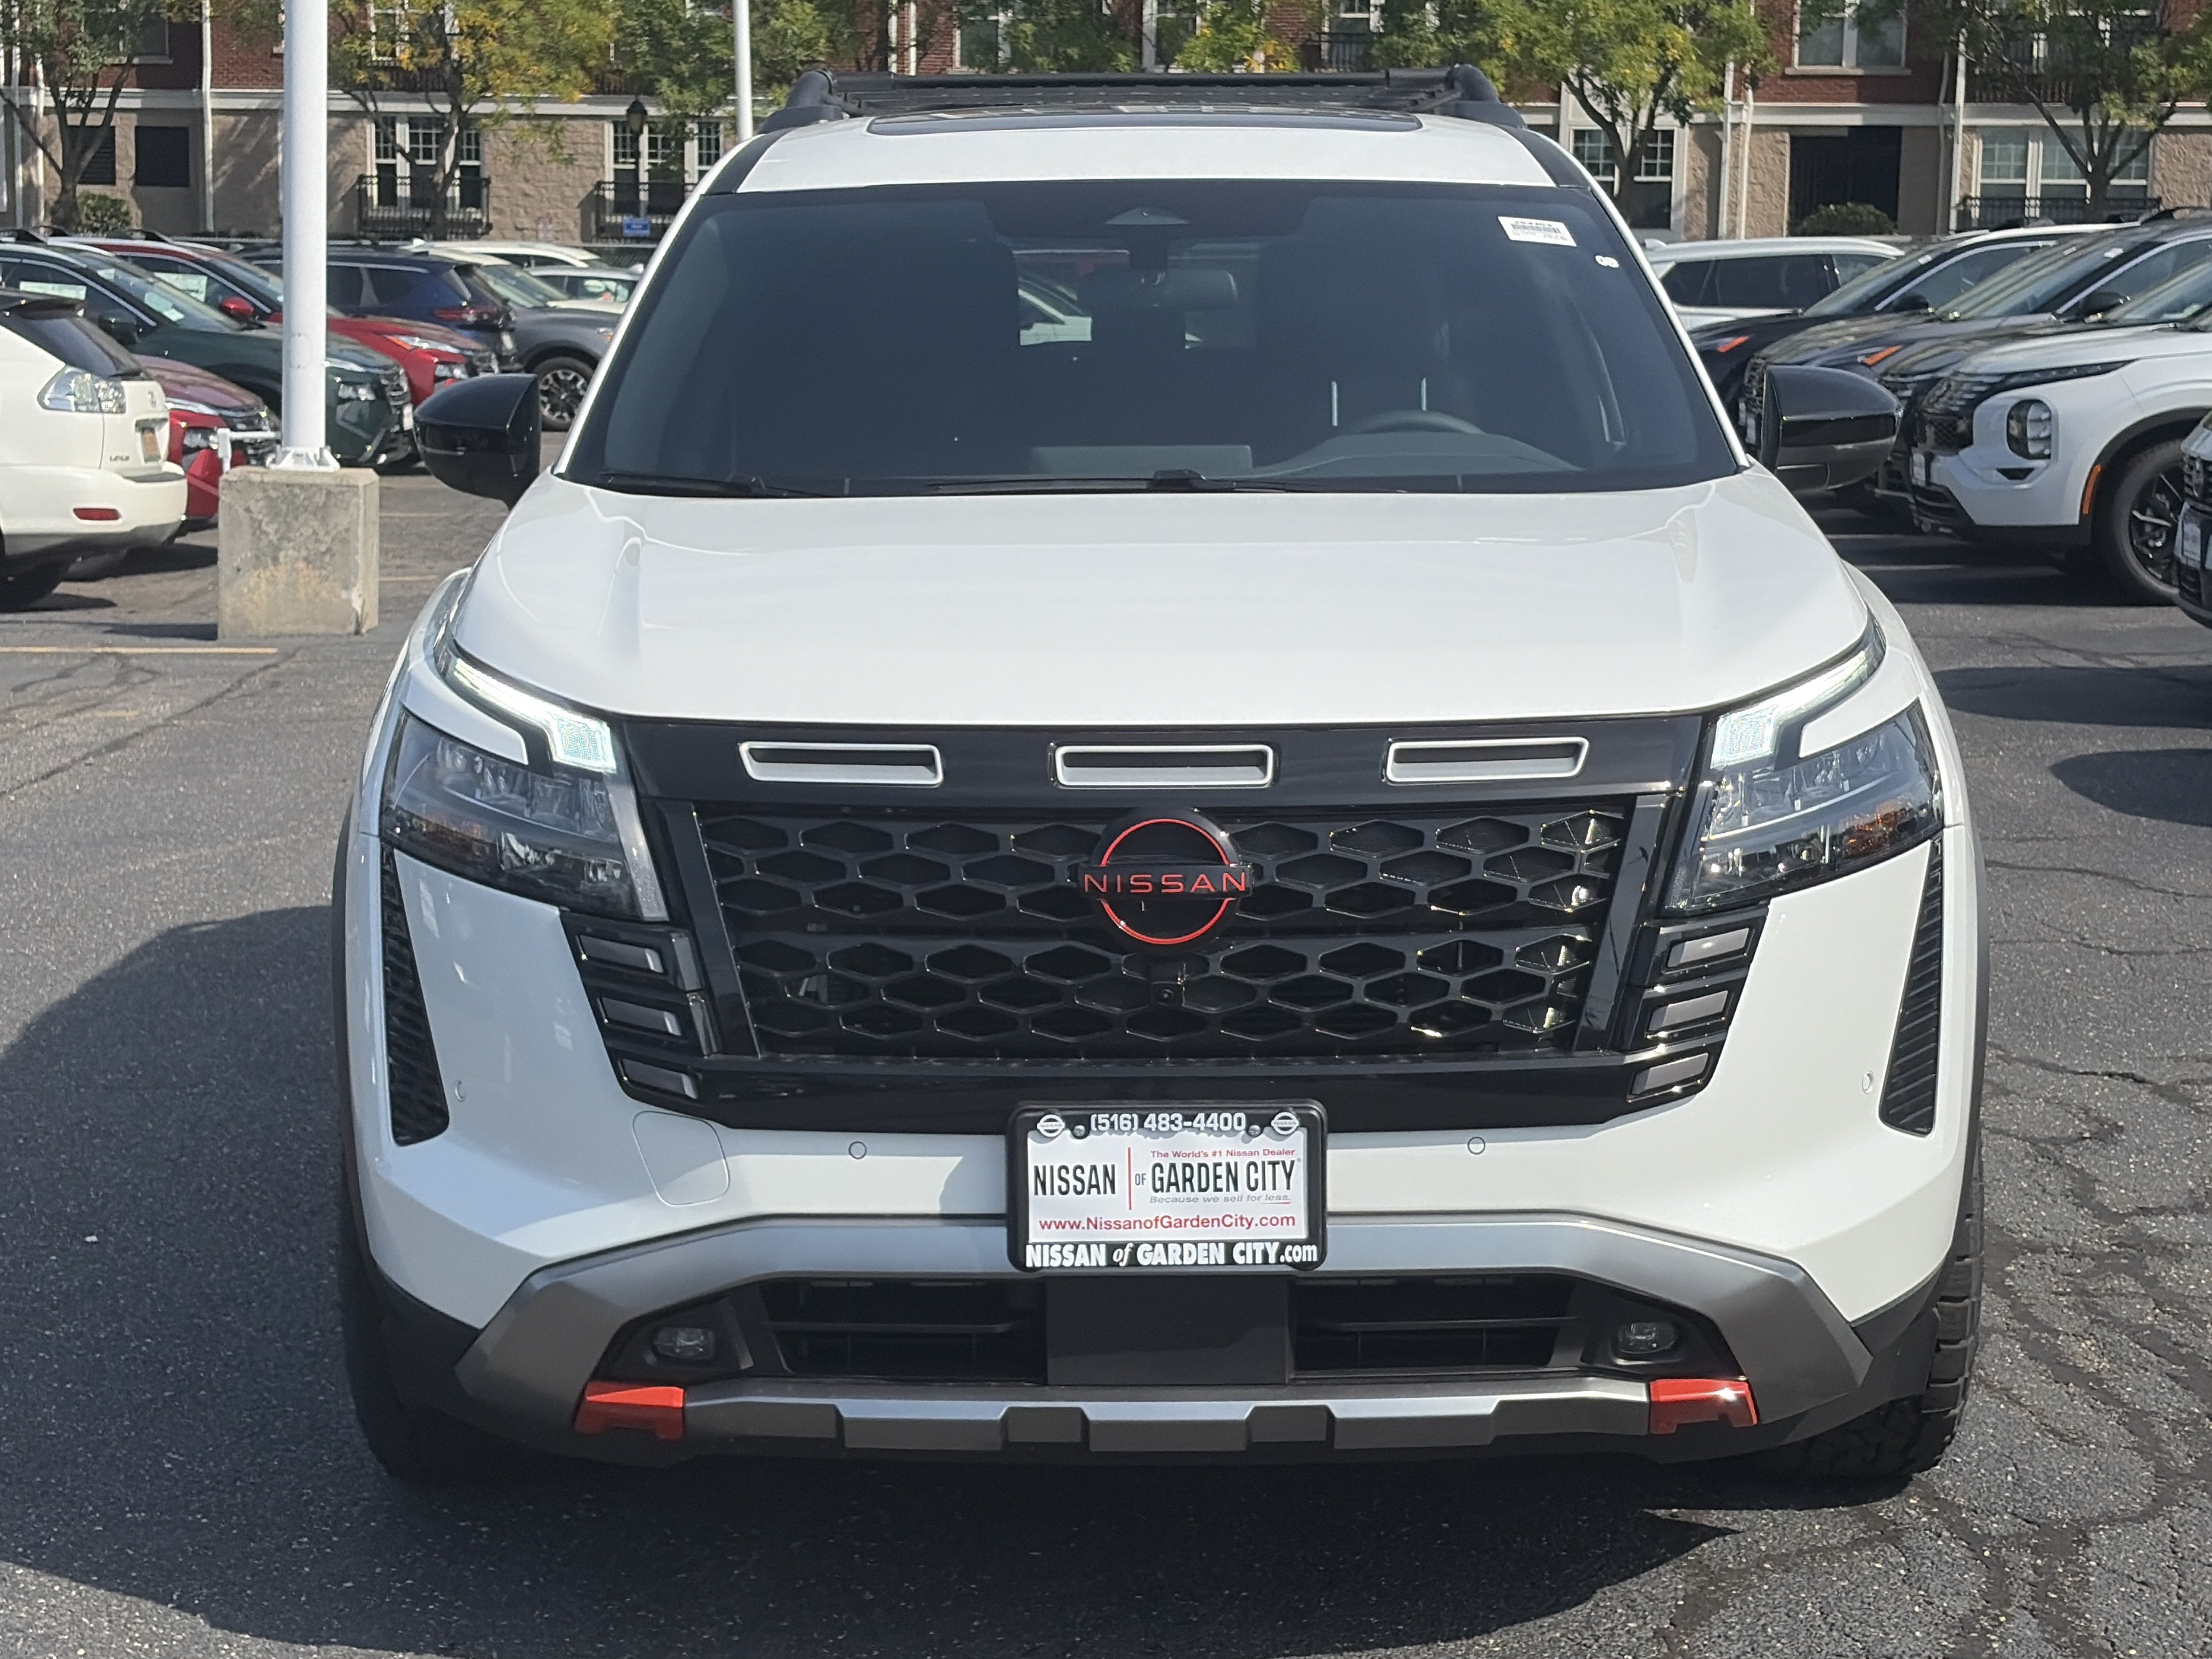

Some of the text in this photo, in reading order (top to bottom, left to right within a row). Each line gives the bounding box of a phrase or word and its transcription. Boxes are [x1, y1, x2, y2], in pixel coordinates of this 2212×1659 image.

[1084, 872, 1246, 893] NISSAN
[1090, 1113, 1246, 1131] (516) 483-4400
[1034, 1160, 1295, 1195] NISSAN OF GARDEN CITY
[1039, 1214, 1296, 1229] www.NissanofGardenCity.com
[1025, 1243, 1107, 1267] NISSAN
[1113, 1243, 1135, 1267] of
[1137, 1242, 1224, 1266] GARDEN
